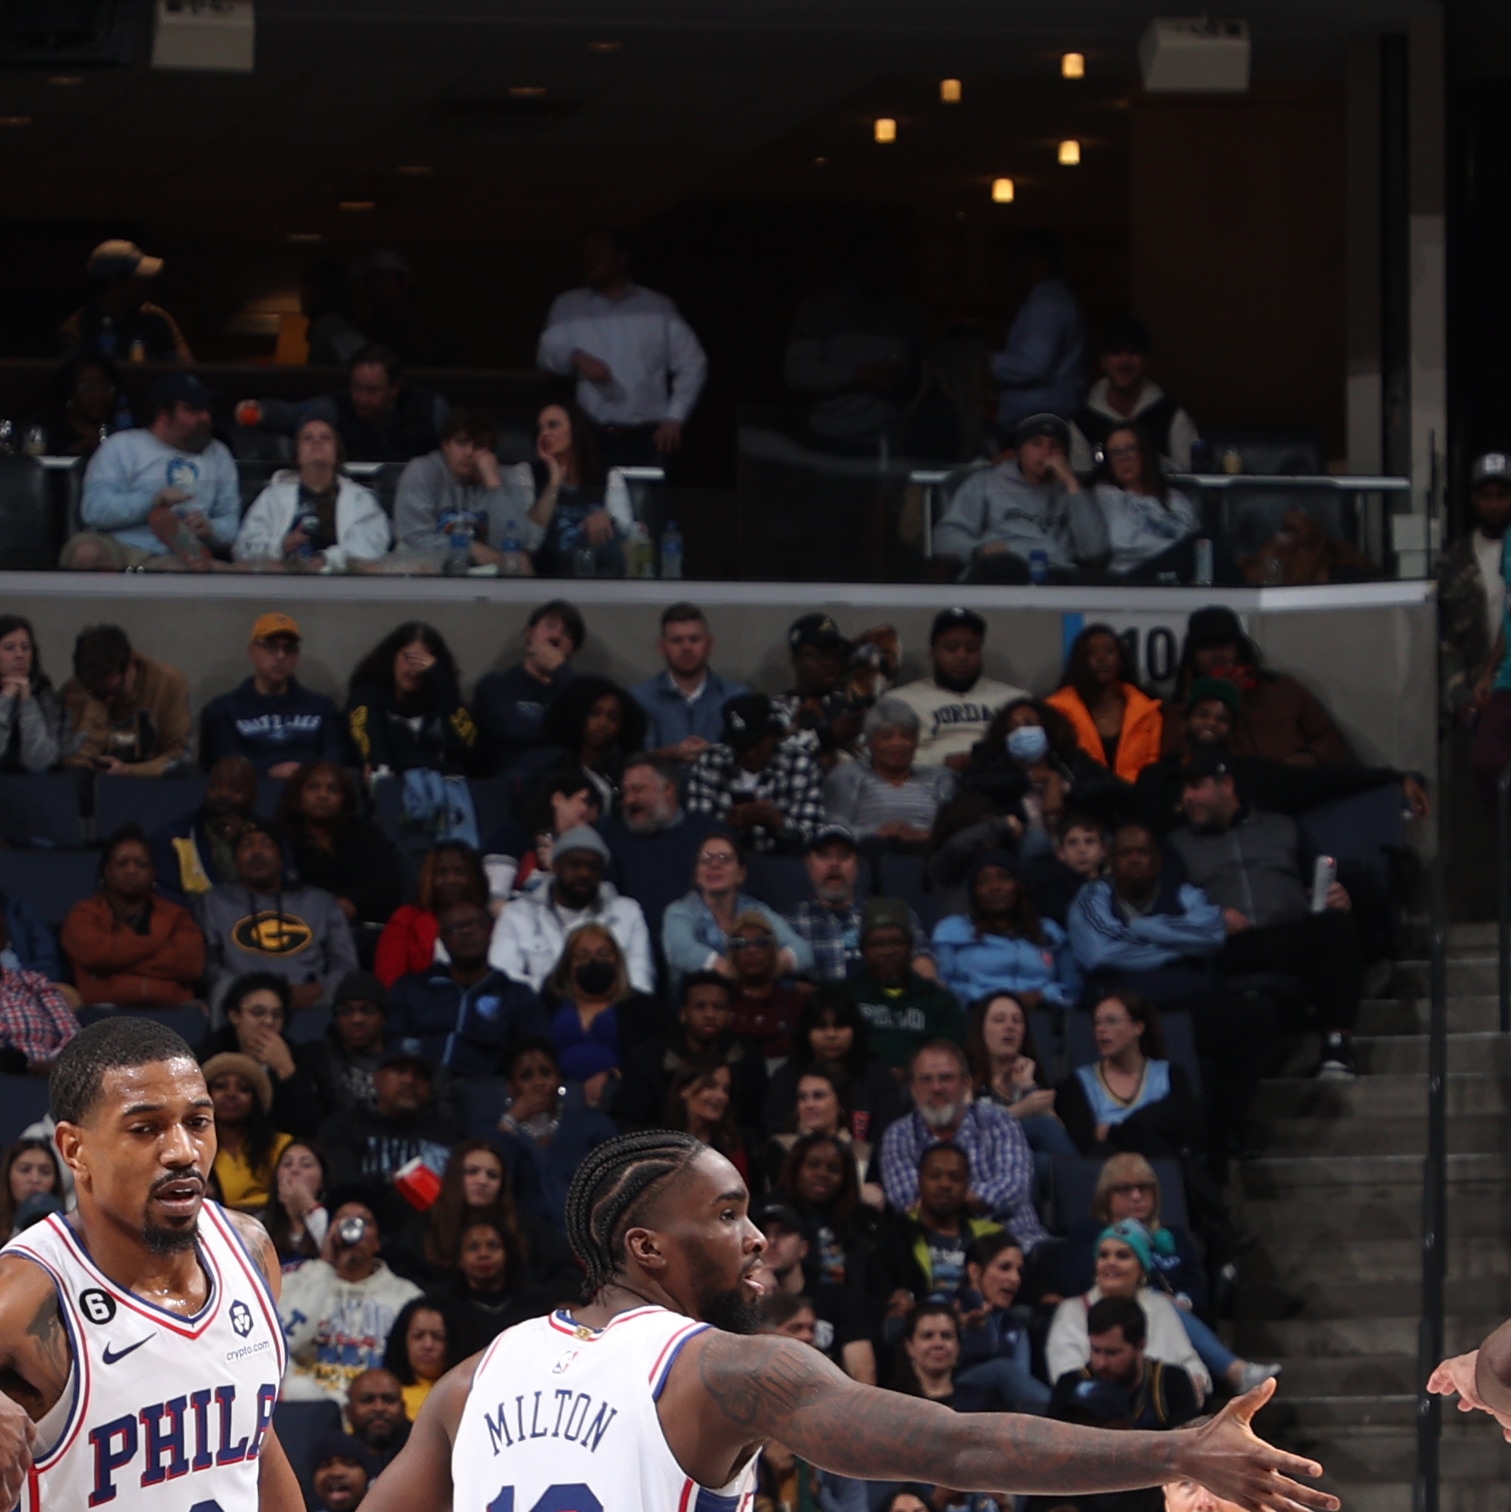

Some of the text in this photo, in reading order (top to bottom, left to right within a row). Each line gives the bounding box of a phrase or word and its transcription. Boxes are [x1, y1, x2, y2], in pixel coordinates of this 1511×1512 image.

[932, 702, 994, 735] JORDA
[86, 1292, 110, 1322] 6
[226, 1340, 270, 1362] crypto.com
[483, 1388, 618, 1457] MILTON
